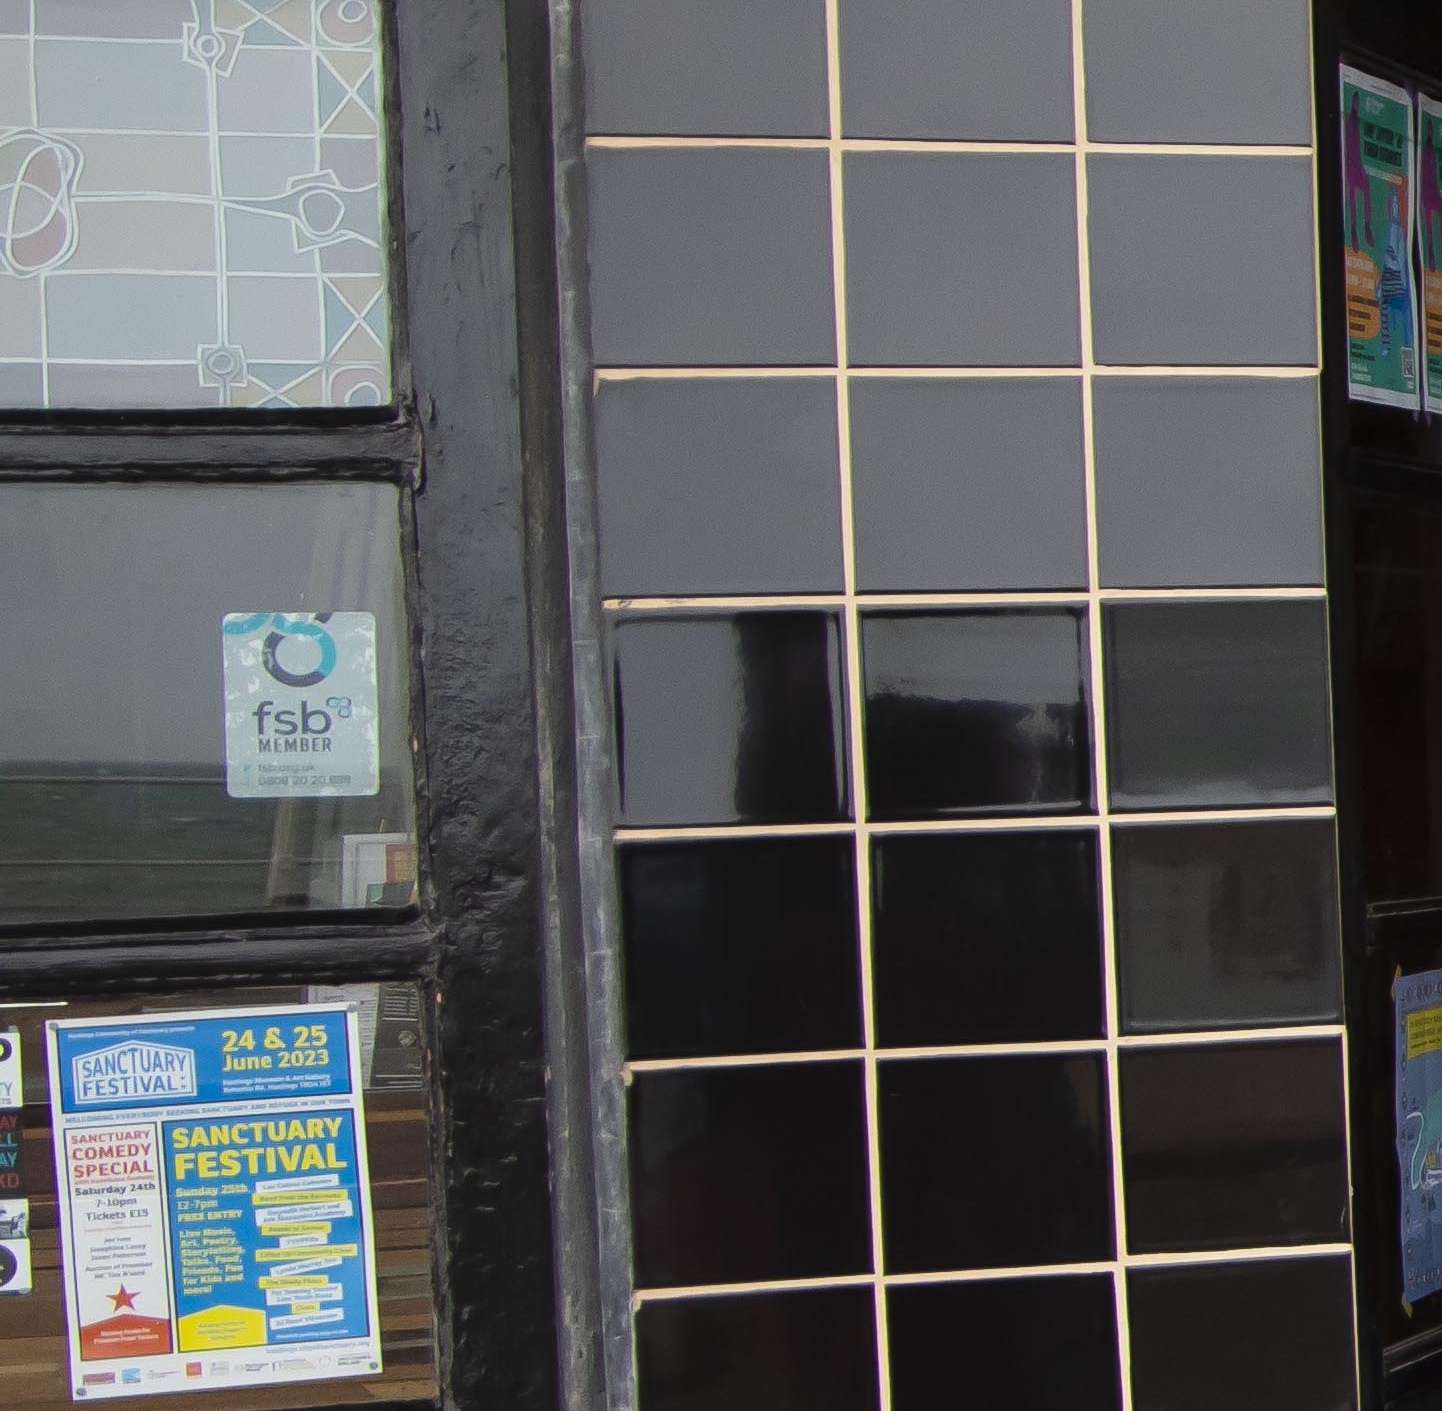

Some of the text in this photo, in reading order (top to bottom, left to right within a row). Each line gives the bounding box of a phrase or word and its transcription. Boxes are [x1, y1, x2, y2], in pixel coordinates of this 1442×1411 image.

[252, 700, 332, 735] fsb
[258, 738, 332, 753] MEMBER
[221, 1025, 327, 1051] 24 & 25
[81, 1044, 187, 1077] SANCTUARY
[222, 1048, 329, 1071] June 2023
[71, 1129, 151, 1144] SANCTUARY
[171, 1117, 343, 1148] SANCTUARY
[72, 1142, 153, 1161] COMEDY
[173, 1142, 347, 1179] FESTIVAL
[73, 1159, 154, 1178] SPECIAL
[74, 1181, 155, 1197] Saturday 24th
[86, 1210, 126, 1221] Tickets
